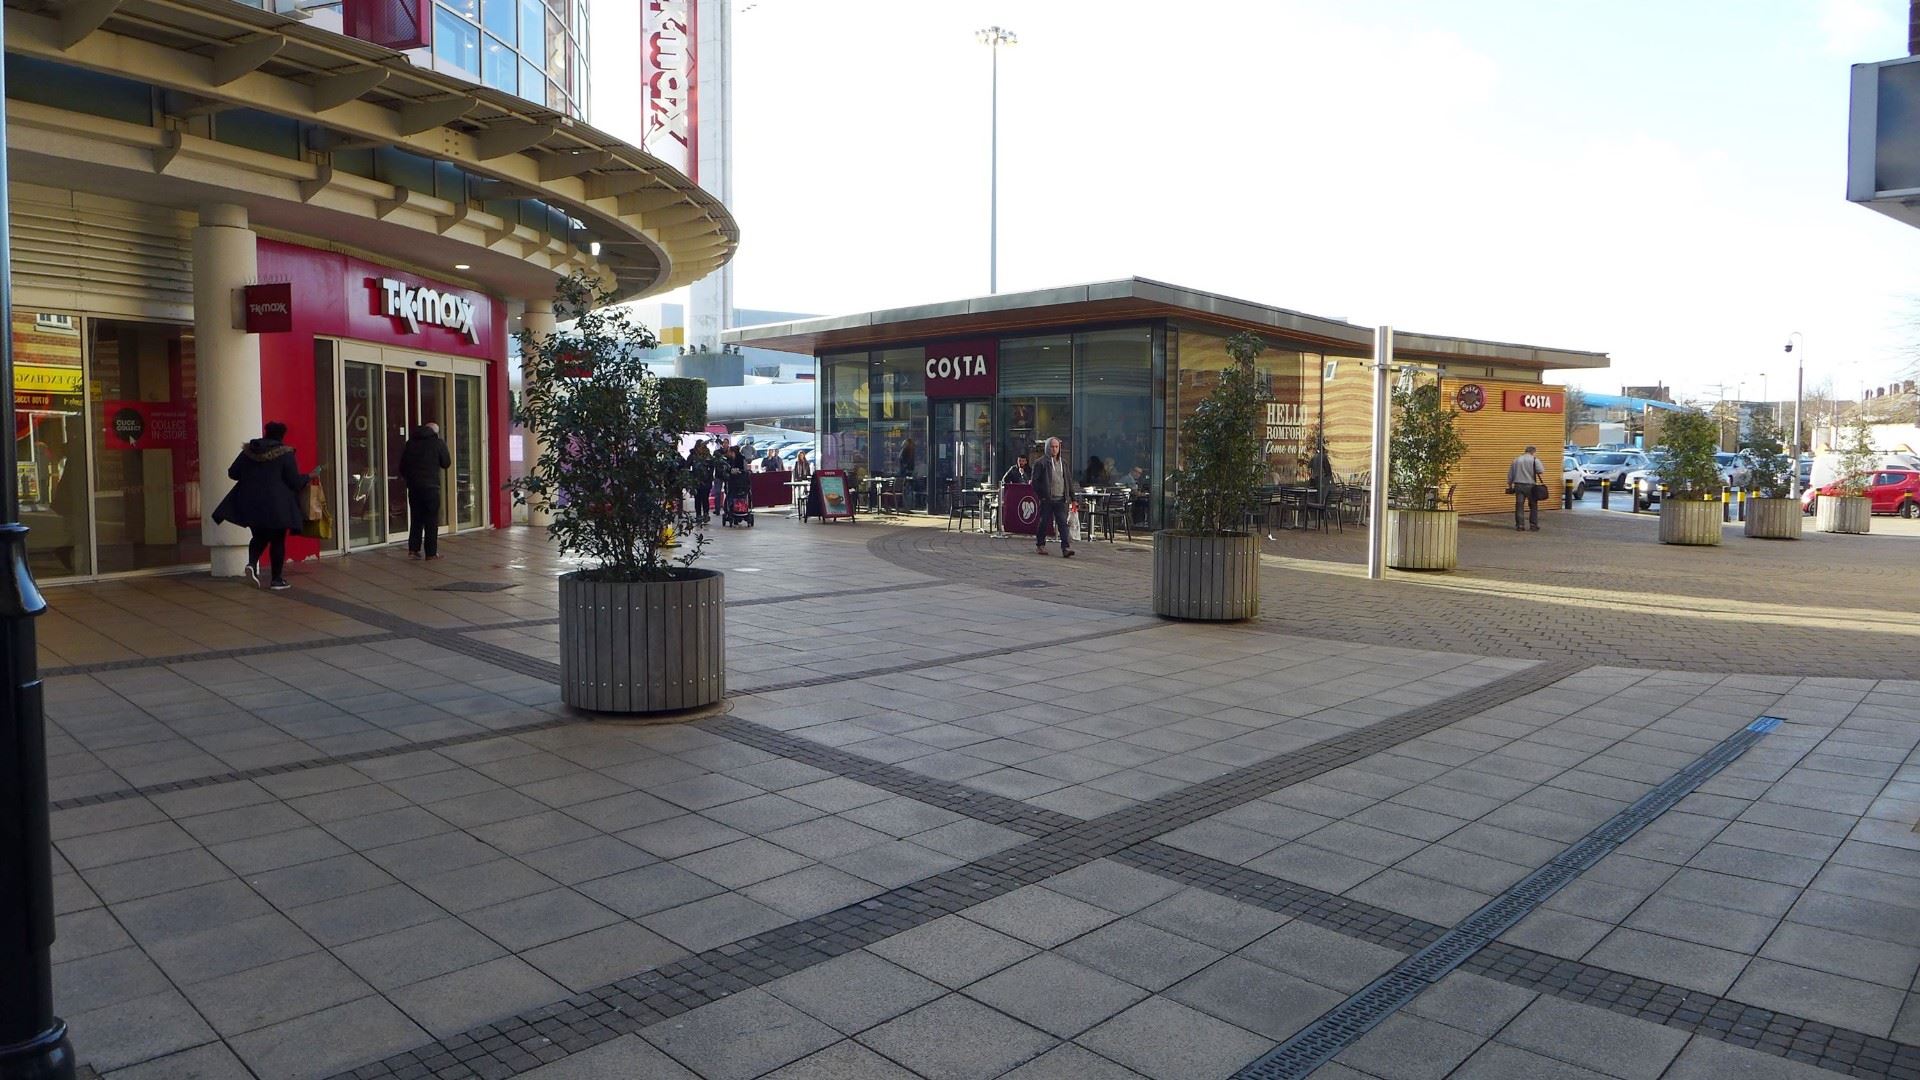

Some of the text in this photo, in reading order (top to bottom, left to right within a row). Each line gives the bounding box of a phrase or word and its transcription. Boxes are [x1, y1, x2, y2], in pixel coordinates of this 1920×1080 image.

[925, 354, 987, 380] COSTA
[1461, 386, 1479, 395] COSTA
[1459, 400, 1480, 410] COFFEE
[1524, 394, 1551, 409] COSTA
[1266, 403, 1308, 425] HELLO
[1266, 426, 1307, 440] ROMFORD
[1265, 440, 1286, 454] Come
[1287, 445, 1298, 454] on
